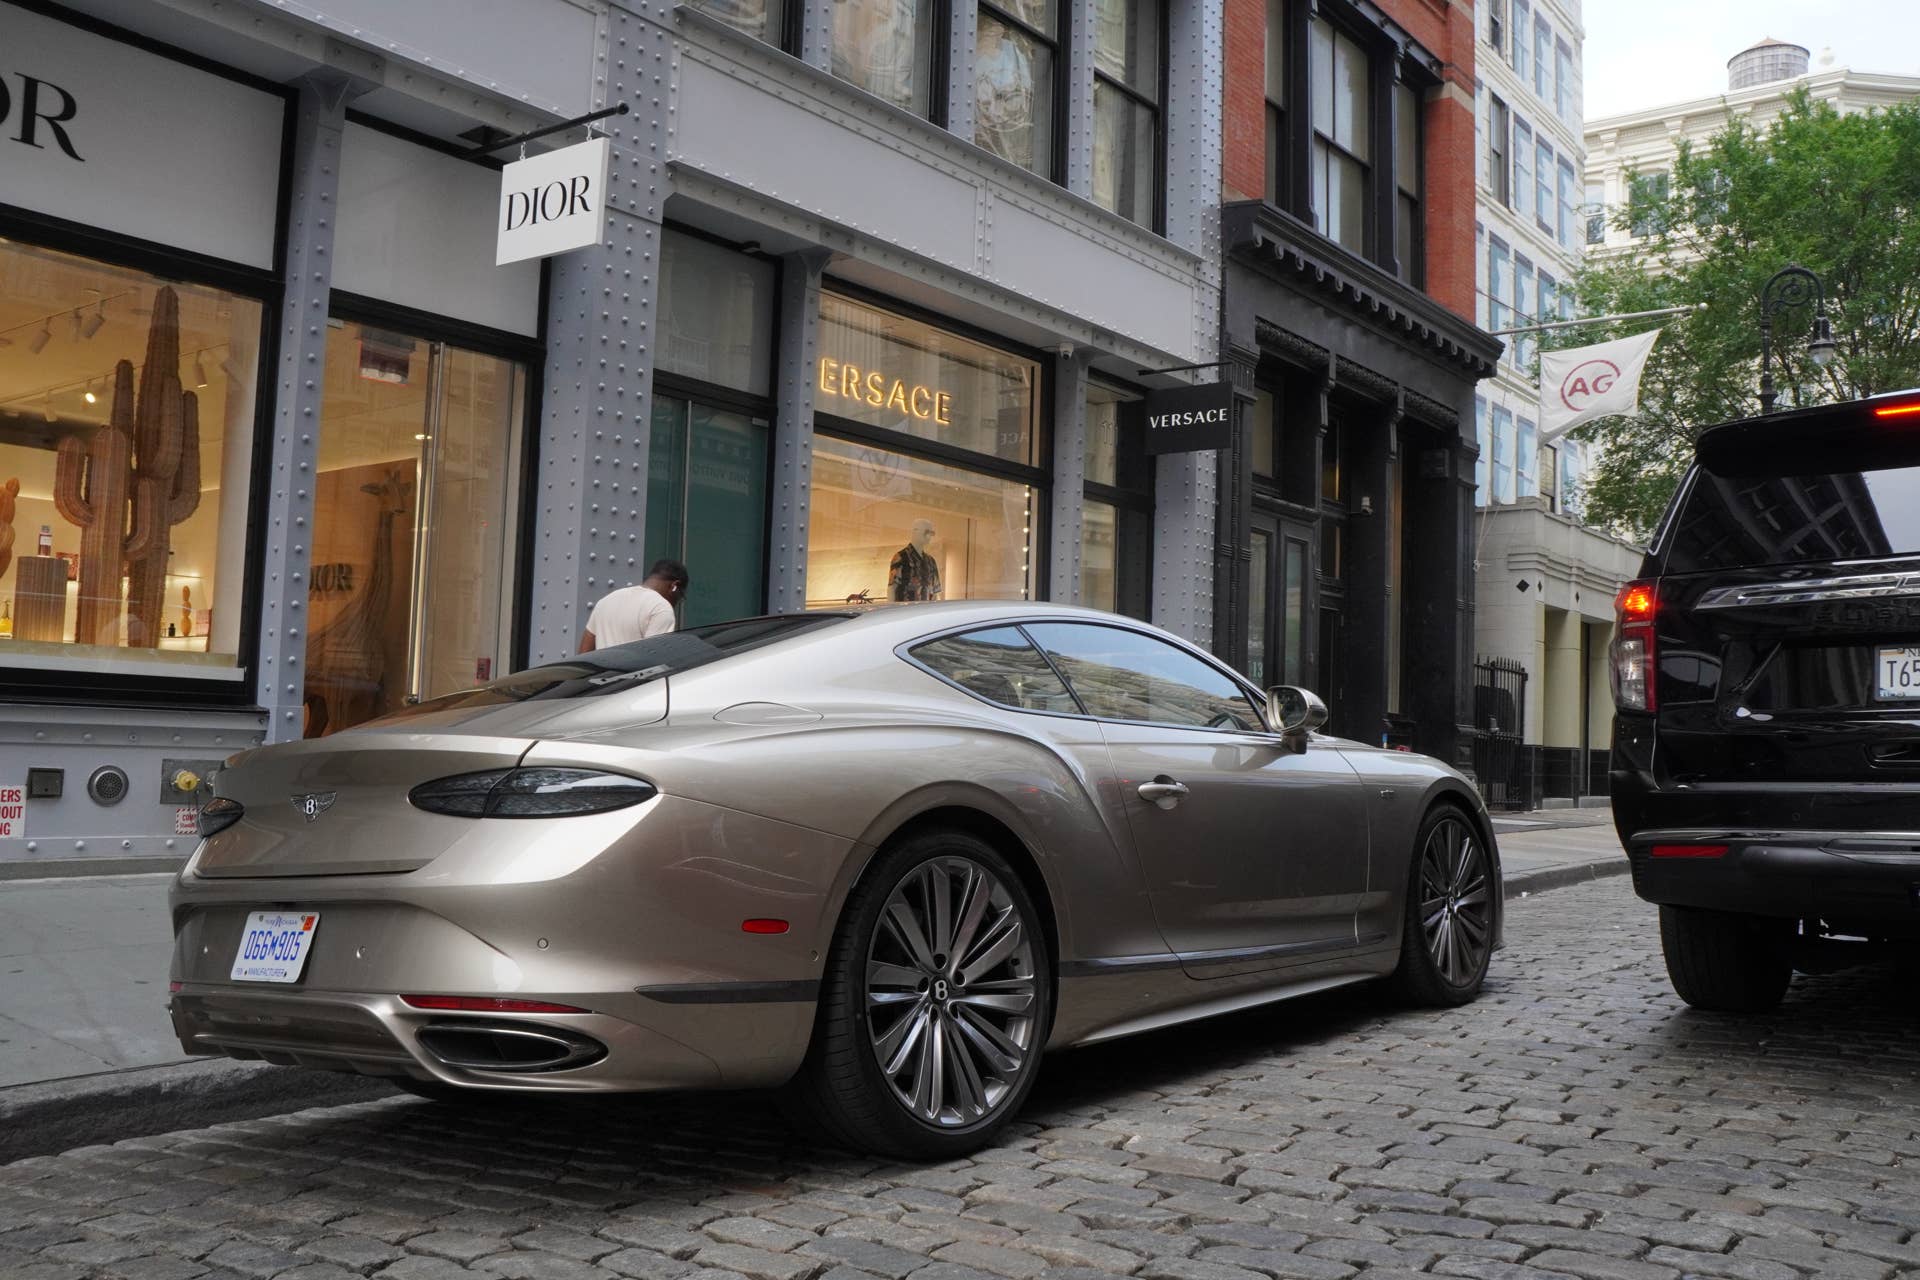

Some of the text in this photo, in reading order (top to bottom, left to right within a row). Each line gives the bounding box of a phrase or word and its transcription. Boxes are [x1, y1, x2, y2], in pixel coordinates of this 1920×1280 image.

[503, 175, 592, 232] DIOR
[820, 358, 953, 424] ERSACE
[1567, 374, 1614, 397] AG
[1149, 408, 1228, 429] VERSACE
[0, 806, 23, 819] OUT
